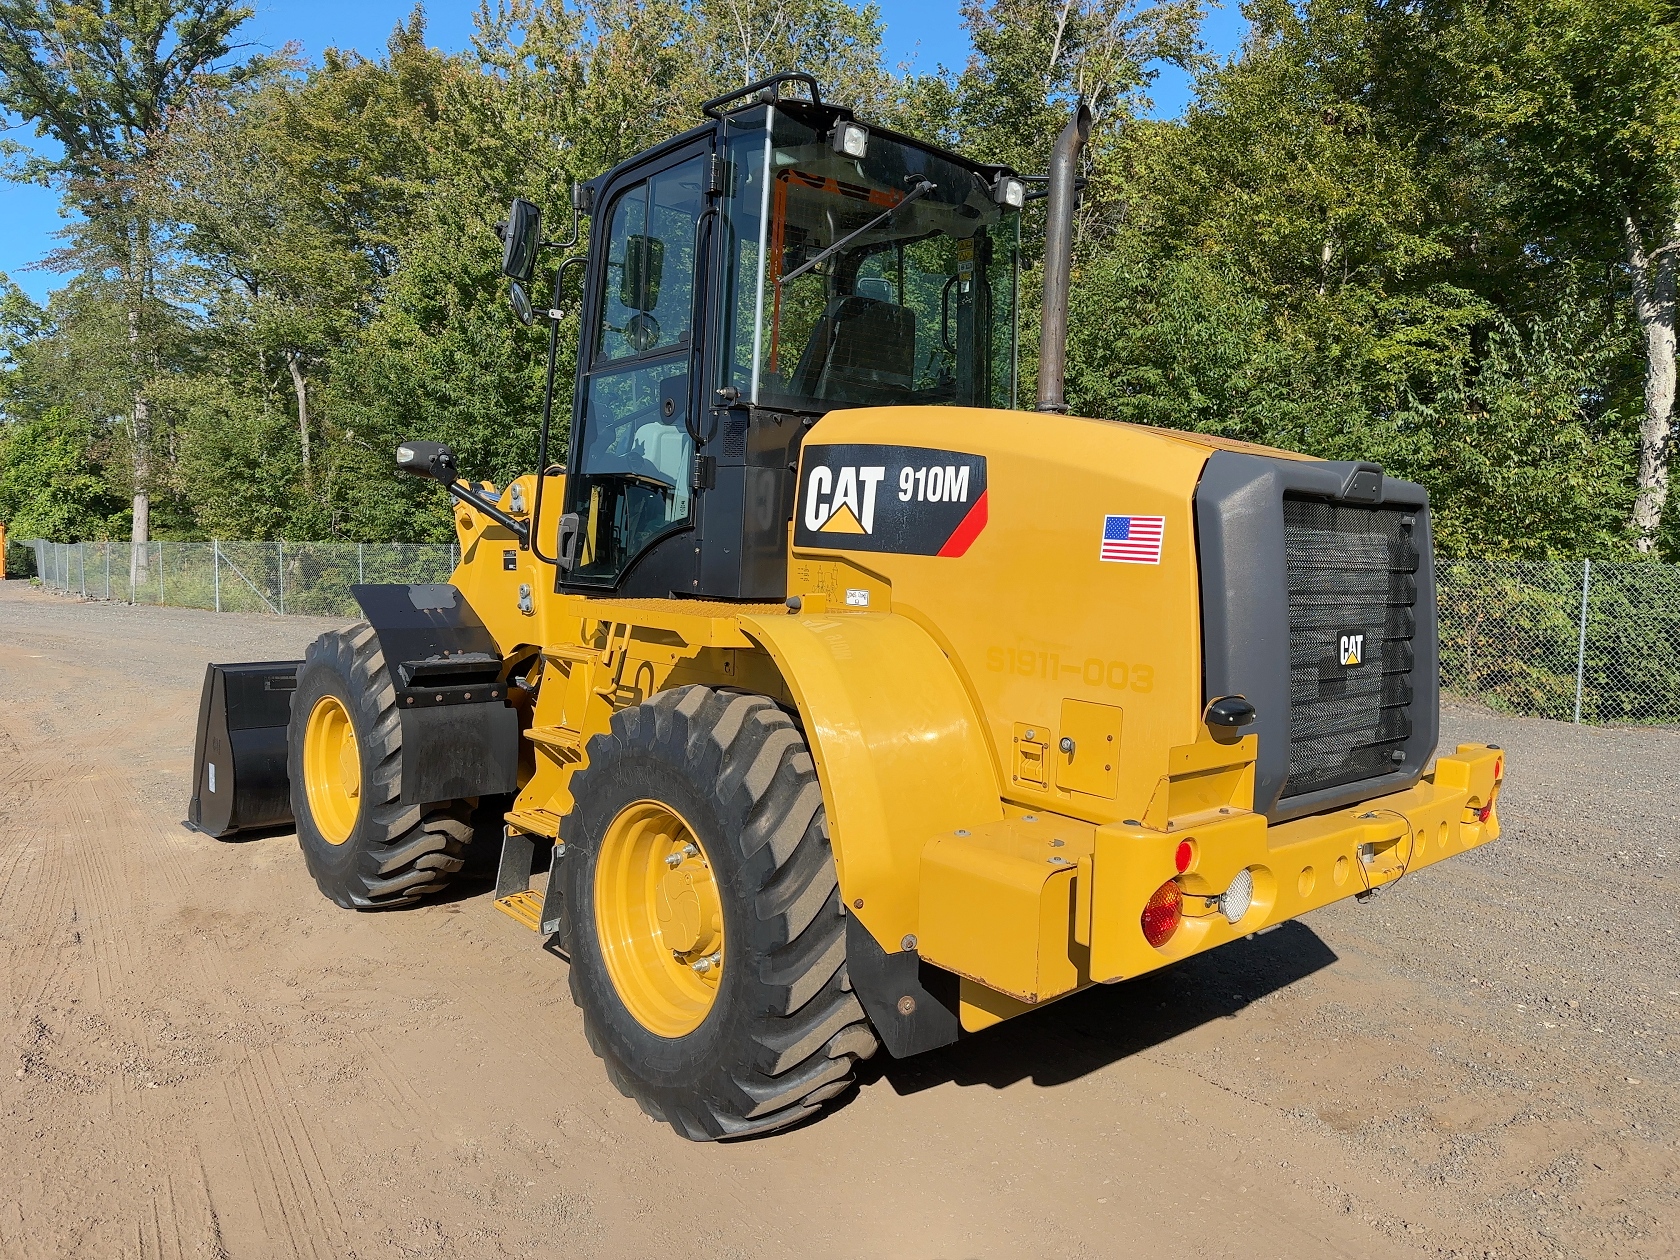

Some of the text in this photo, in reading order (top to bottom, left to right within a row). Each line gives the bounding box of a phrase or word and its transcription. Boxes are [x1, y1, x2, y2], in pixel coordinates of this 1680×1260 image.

[805, 465, 970, 534] CAT 910M
[985, 645, 1155, 694] S1911-003
[1340, 634, 1364, 666] CAT
